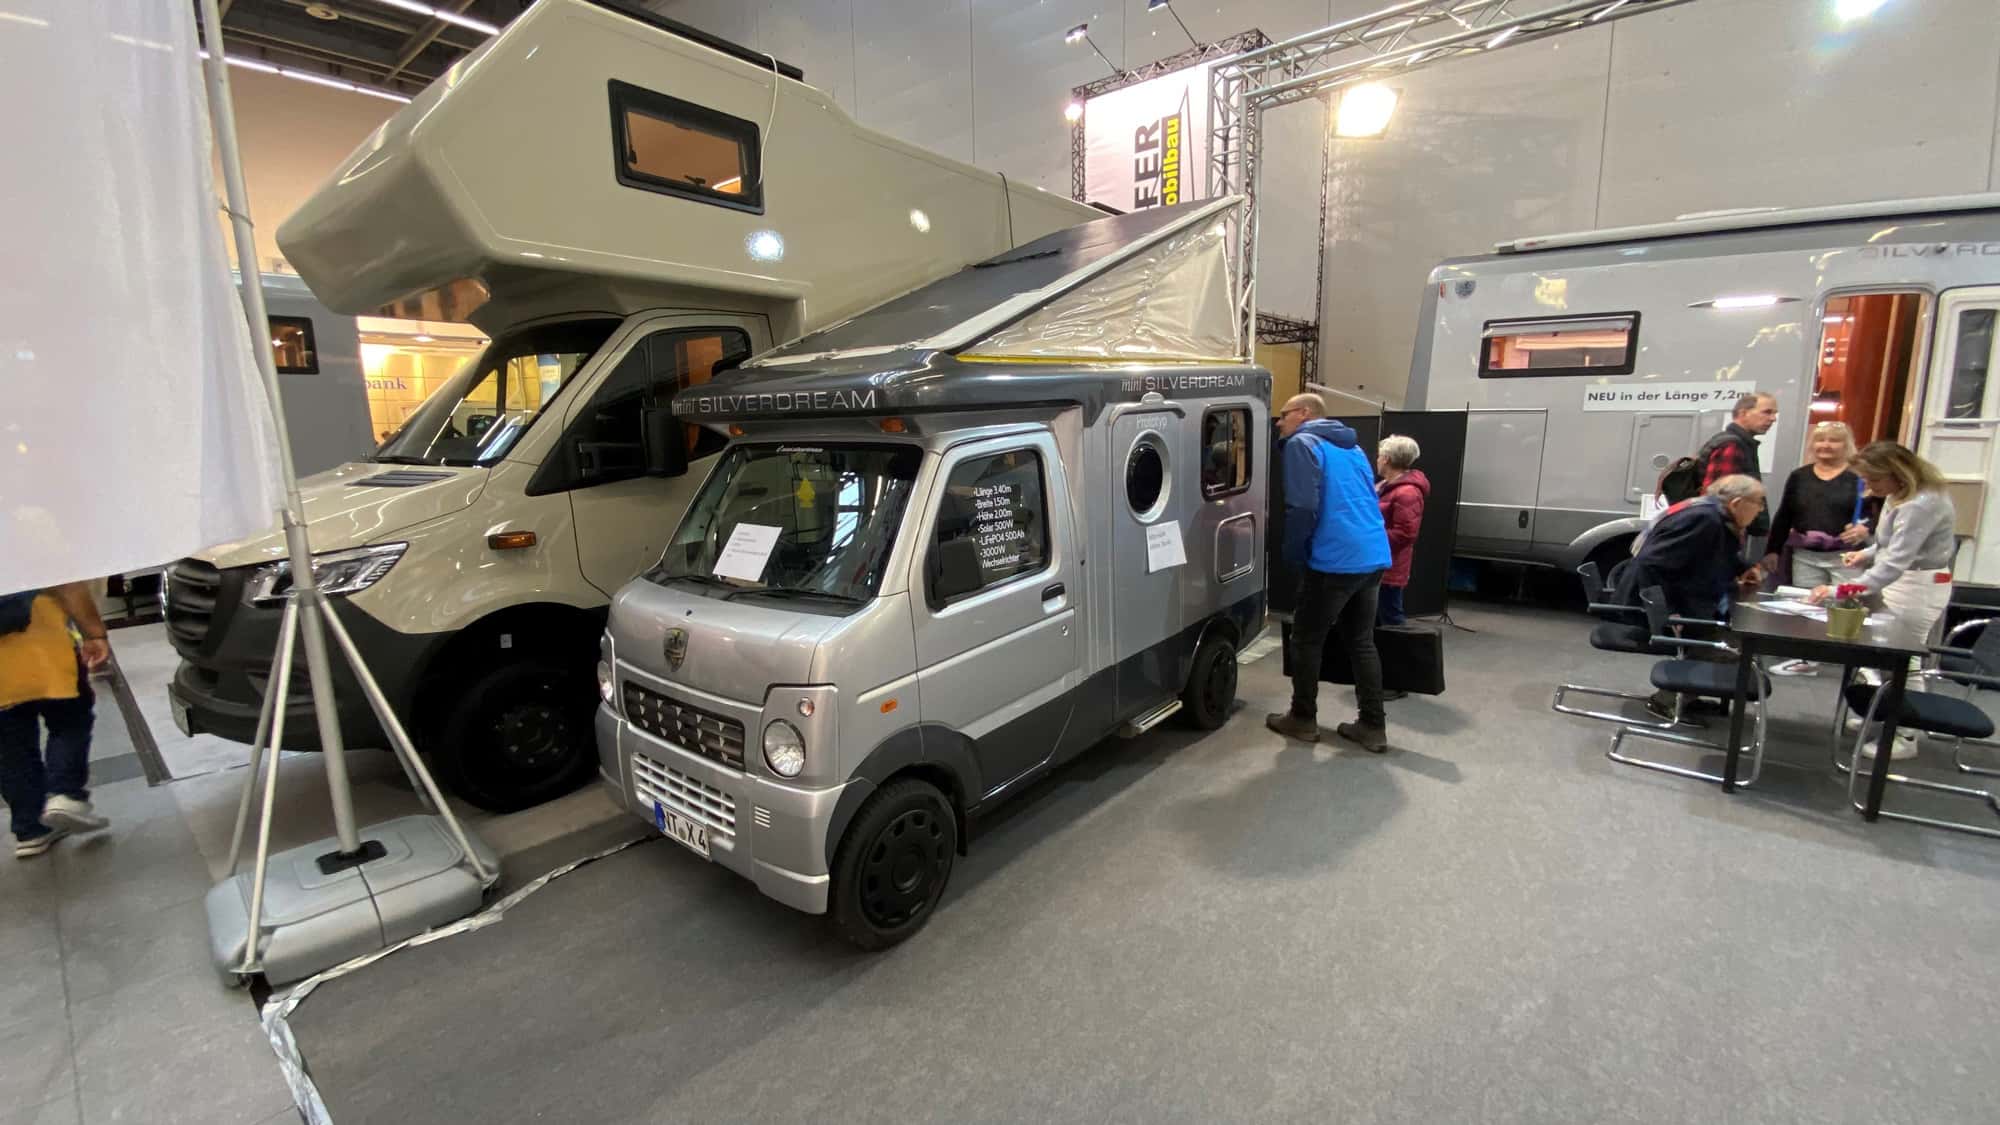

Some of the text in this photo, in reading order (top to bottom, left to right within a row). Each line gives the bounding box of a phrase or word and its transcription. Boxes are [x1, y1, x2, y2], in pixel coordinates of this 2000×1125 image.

[1145, 375, 1245, 391] SILVERDREAM
[699, 390, 876, 413] SILVERDREAM
[1588, 392, 1616, 401] NEU
[1620, 391, 1633, 401] in
[1637, 391, 1661, 401] der
[1665, 390, 1709, 402] Länge
